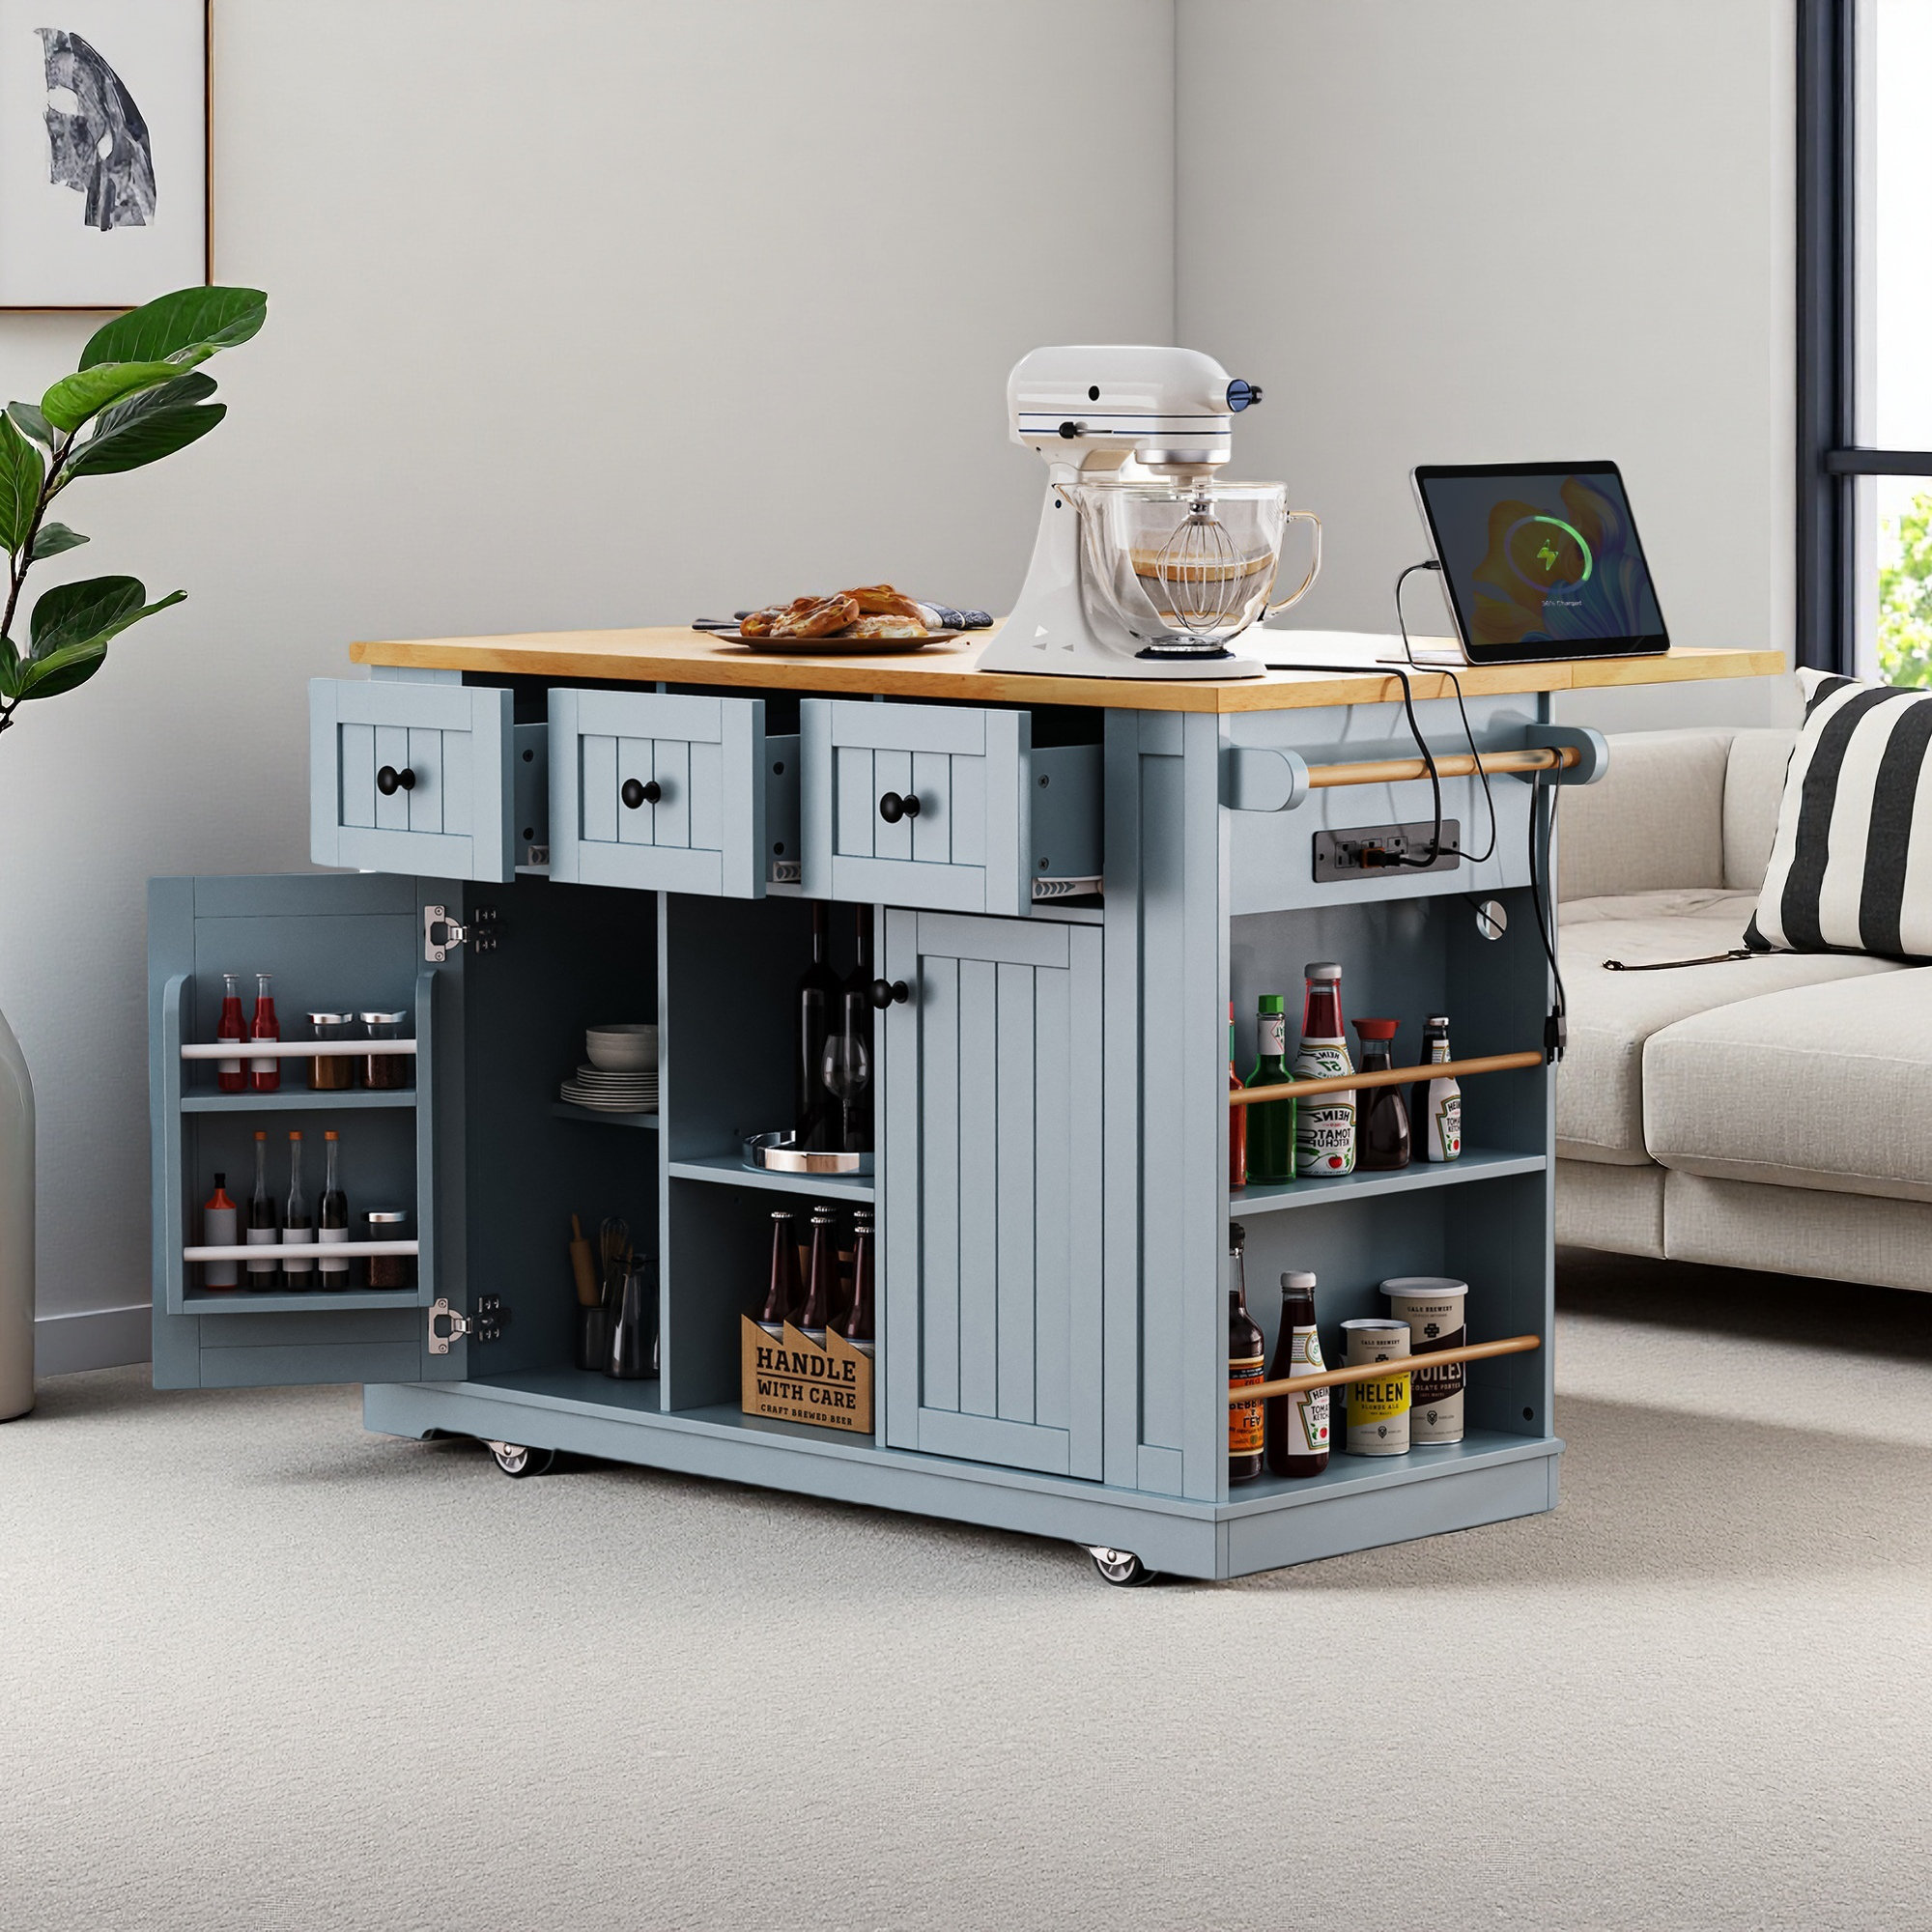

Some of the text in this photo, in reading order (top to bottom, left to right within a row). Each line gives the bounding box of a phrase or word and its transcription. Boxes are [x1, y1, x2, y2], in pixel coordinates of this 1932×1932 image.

[756, 1347, 856, 1382] HANDLE
[757, 1378, 856, 1409] WITH CARE
[1355, 1382, 1403, 1403] HELEN
[760, 1404, 852, 1426] CRAFT BREWED BEER
